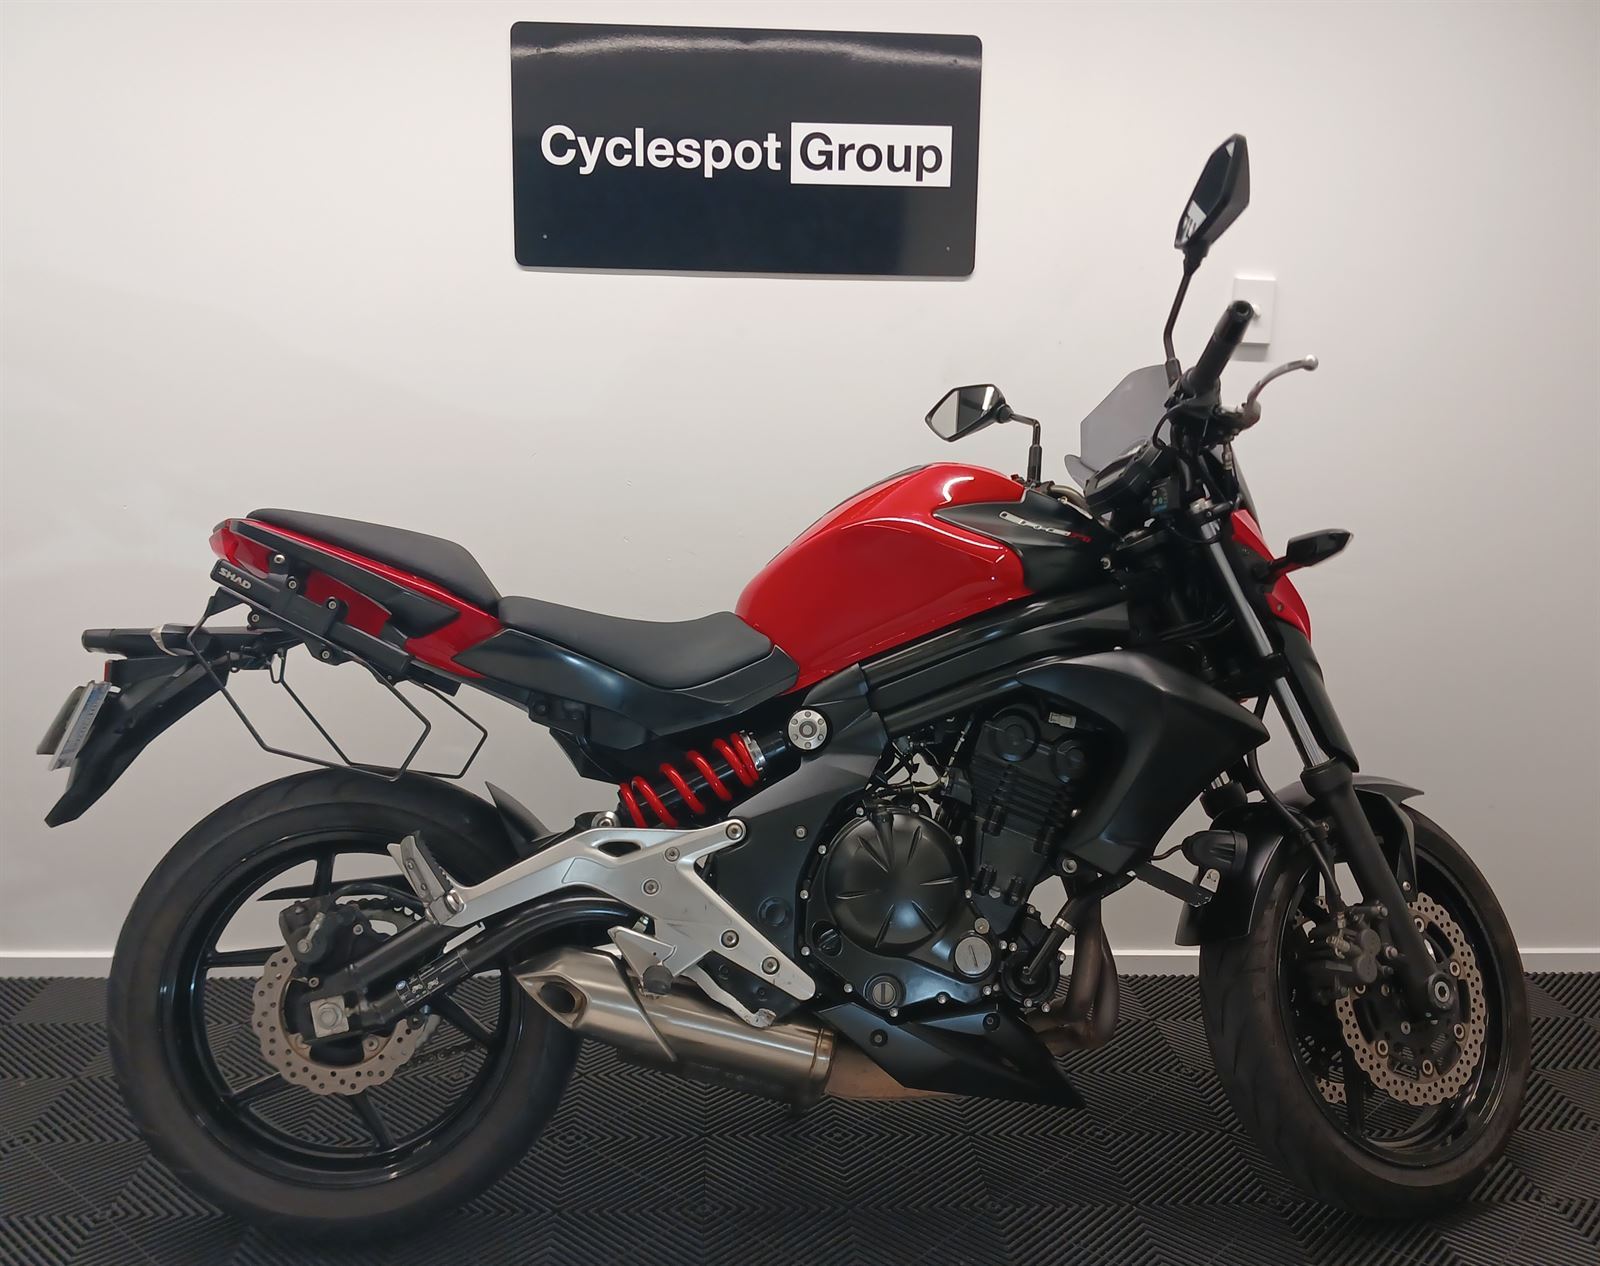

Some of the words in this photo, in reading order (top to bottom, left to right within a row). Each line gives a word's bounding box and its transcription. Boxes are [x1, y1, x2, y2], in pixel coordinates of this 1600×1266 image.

[540, 124, 782, 178] Cyclespot
[800, 131, 944, 182] Group
[218, 567, 251, 589] SHAD
